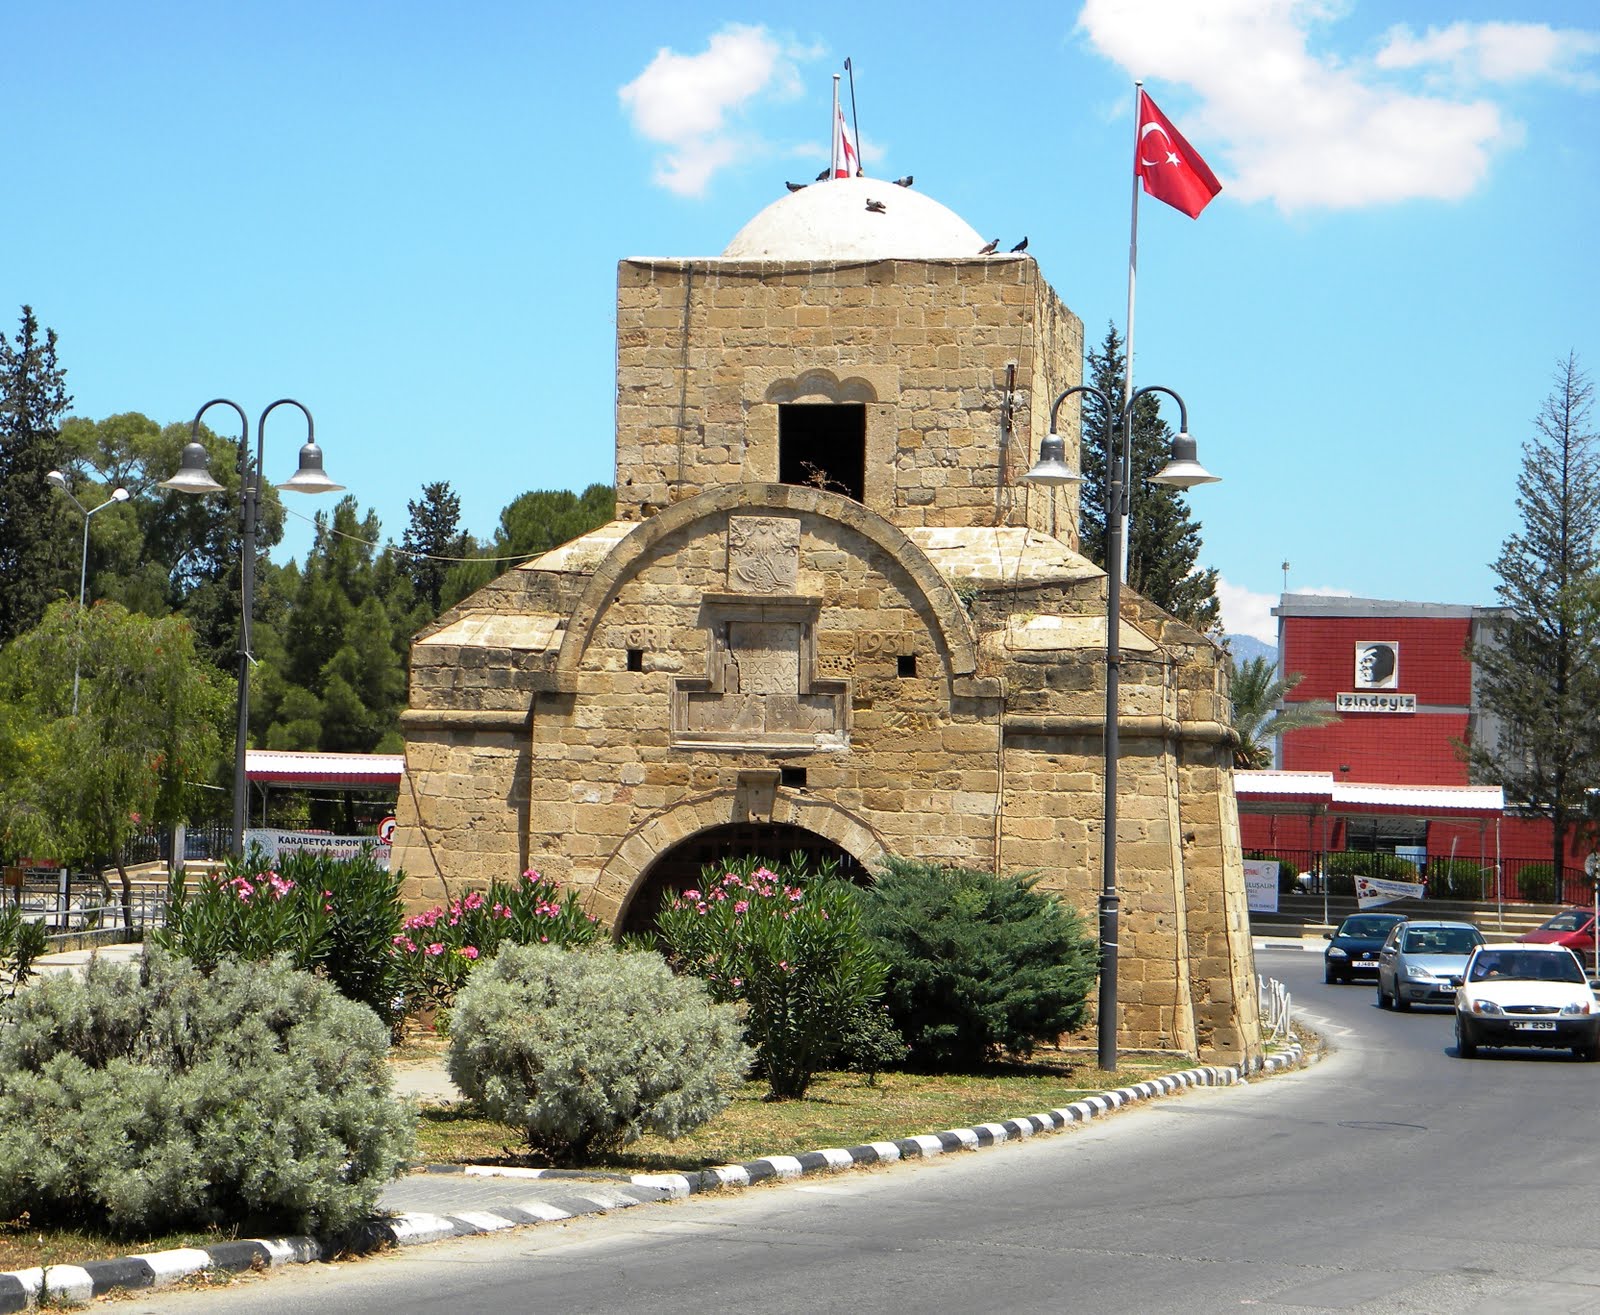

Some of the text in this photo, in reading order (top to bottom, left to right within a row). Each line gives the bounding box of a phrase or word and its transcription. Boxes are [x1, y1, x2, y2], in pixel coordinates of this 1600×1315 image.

[857, 632, 906, 654] 1931
[1338, 694, 1414, 711] izindeyiz
[277, 836, 333, 847] KARABETÇA
[335, 839, 360, 847] SPOR
[1531, 1021, 1554, 1029] 239
